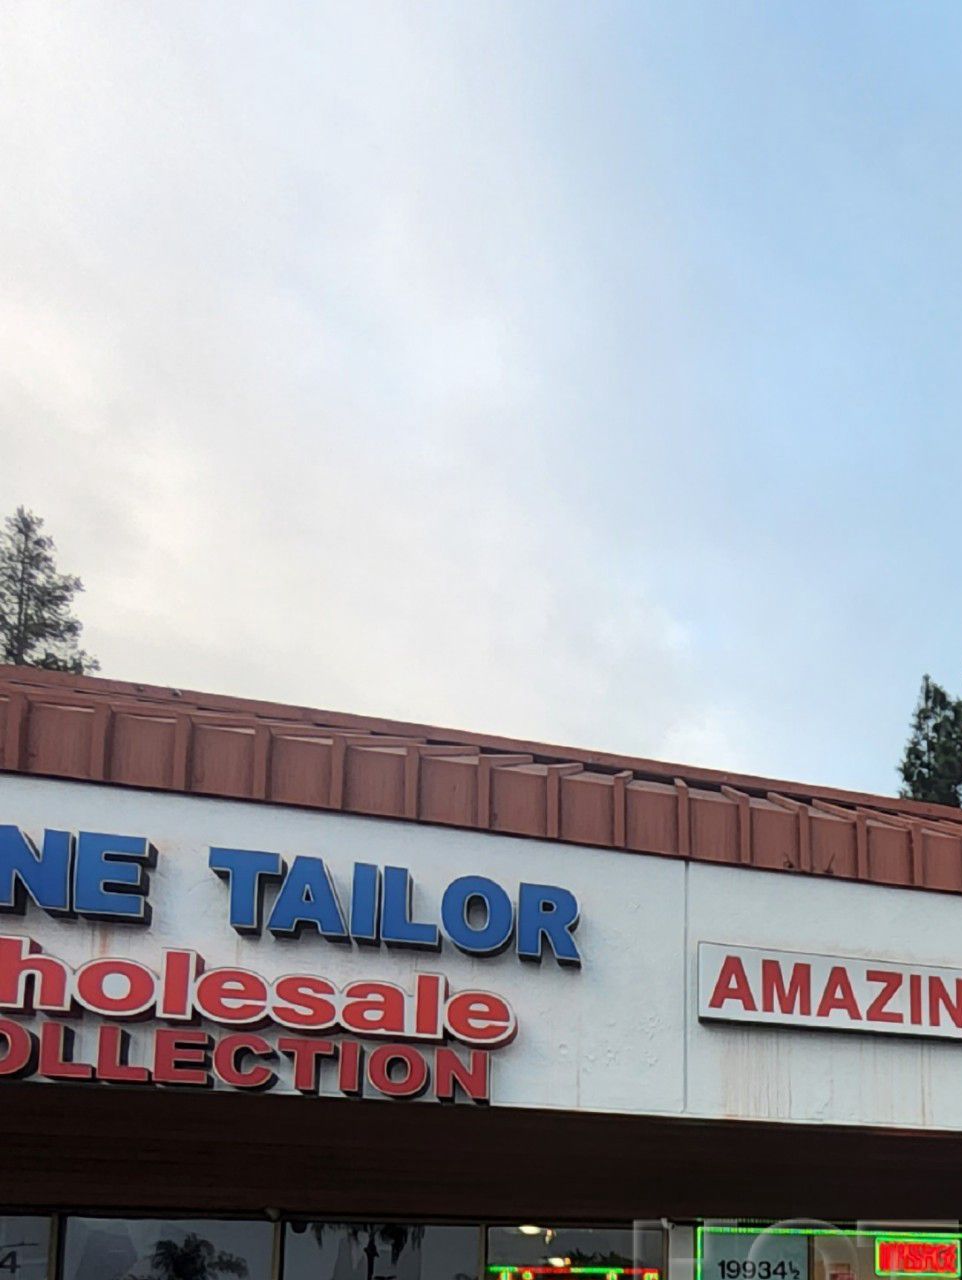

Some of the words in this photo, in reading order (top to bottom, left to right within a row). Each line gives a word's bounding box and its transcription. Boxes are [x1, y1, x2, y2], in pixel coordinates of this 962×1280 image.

[0, 825, 155, 921] NE
[209, 846, 581, 966] TAILOR
[0, 934, 517, 1046] holesale
